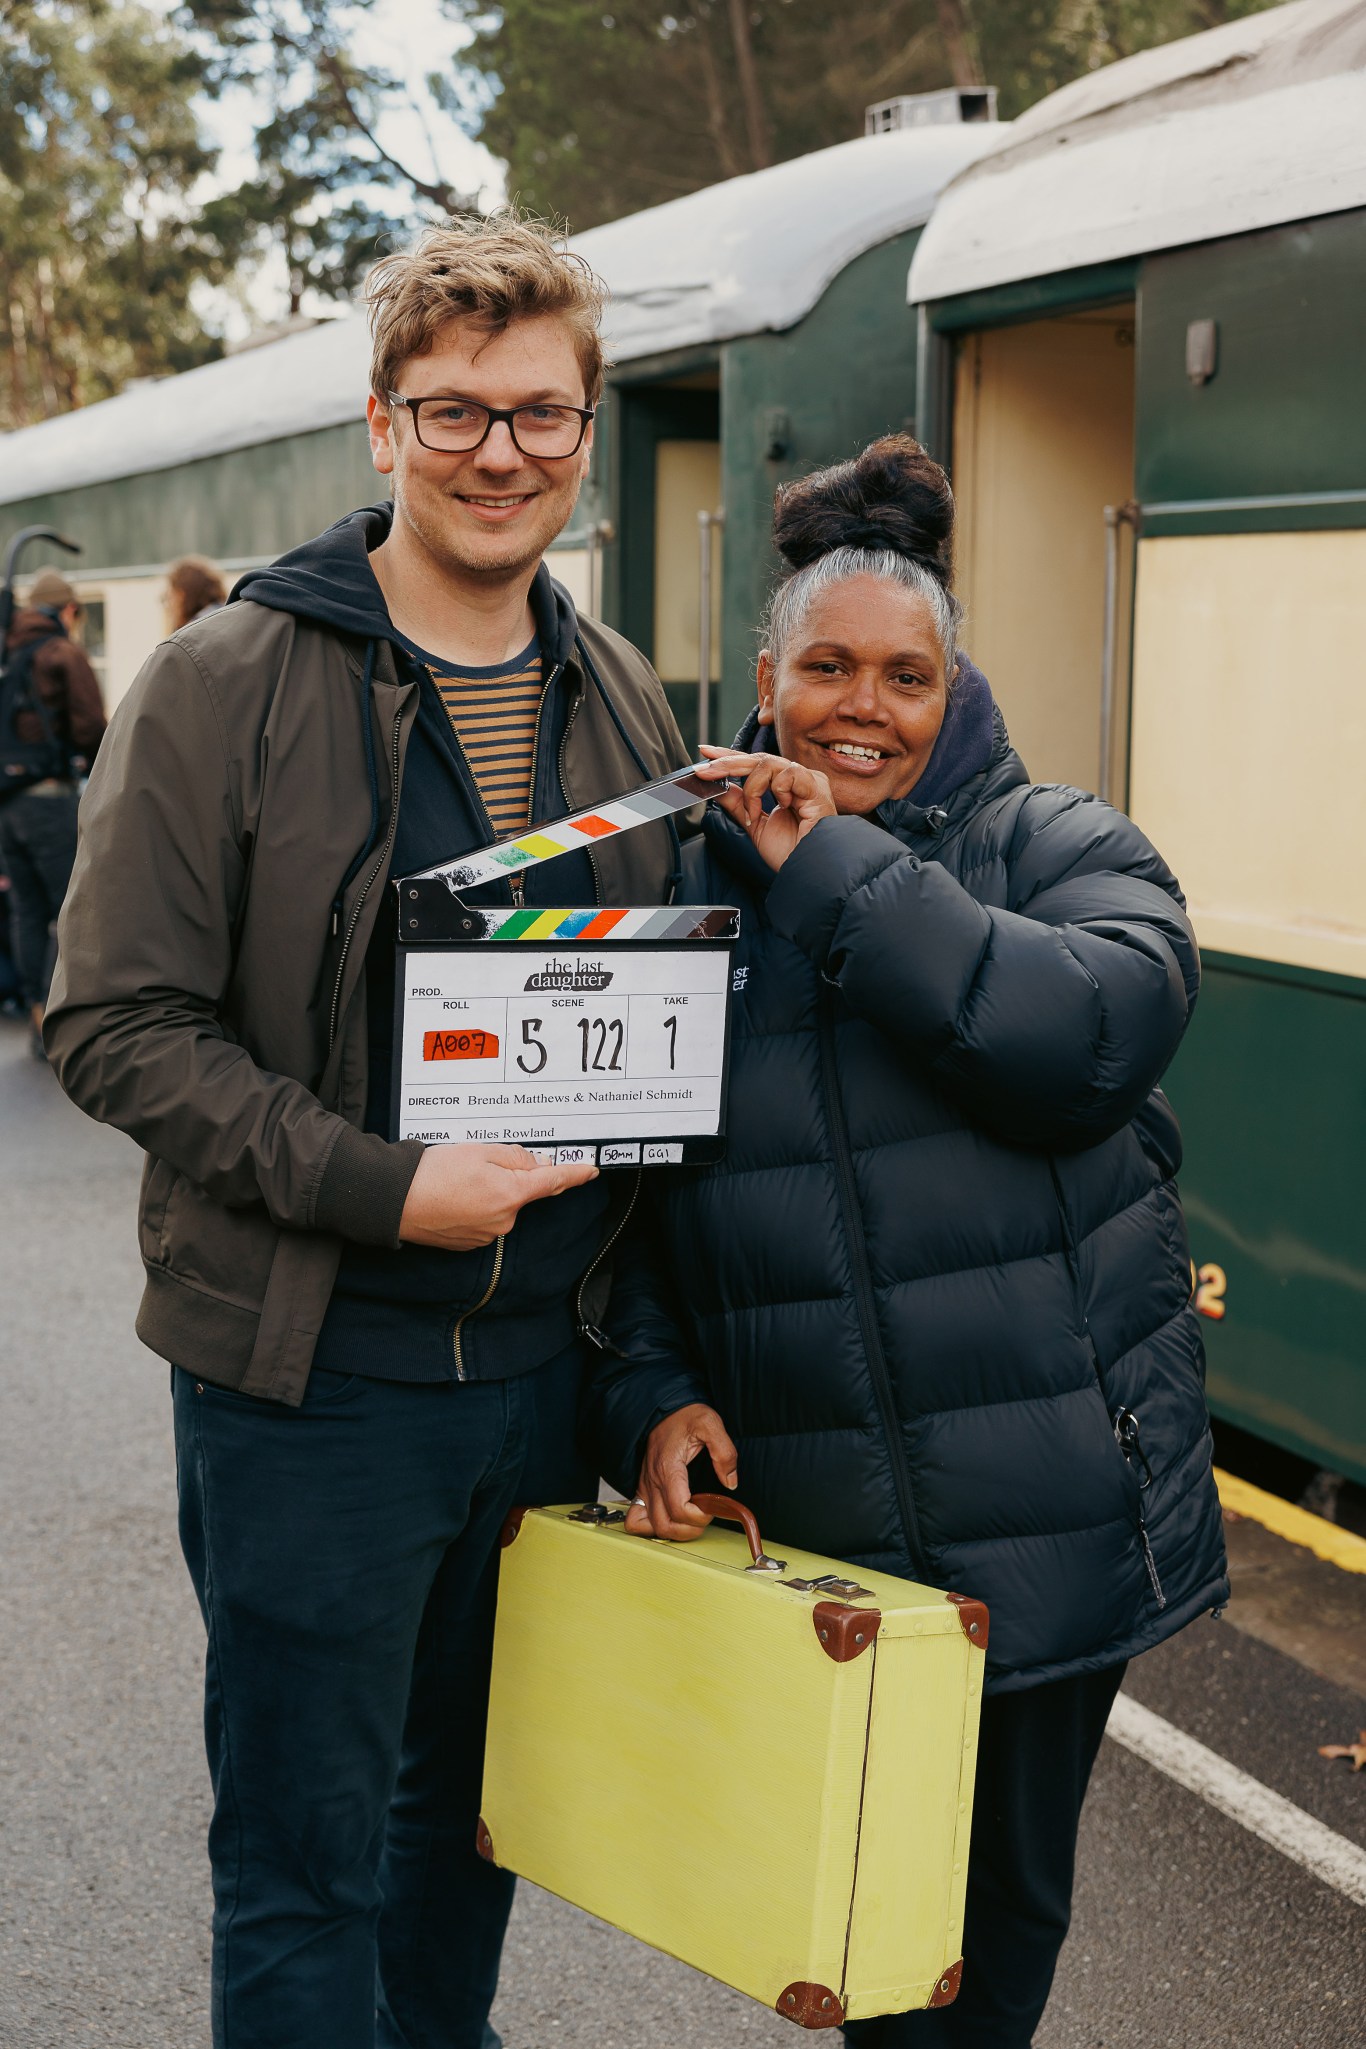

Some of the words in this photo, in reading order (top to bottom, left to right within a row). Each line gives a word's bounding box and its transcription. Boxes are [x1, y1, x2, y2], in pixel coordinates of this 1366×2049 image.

[545, 957, 572, 974] the
[576, 957, 603, 974] last
[531, 972, 605, 991] daughter
[412, 988, 443, 996] PROD.
[443, 1001, 470, 1010] ROLL
[551, 999, 585, 1007] SCENE
[663, 997, 689, 1005] TAKE
[431, 1032, 486, 1061] A007
[516, 1018, 548, 1074] 5
[576, 1017, 624, 1072] 122
[663, 1015, 677, 1070] 1
[408, 1097, 460, 1106] DIRECTOR
[467, 1095, 510, 1106] Brenda
[513, 1093, 570, 1104] Matthews
[573, 1092, 585, 1103] &
[588, 1090, 643, 1102] Nathaniel
[646, 1088, 693, 1100] Schmidt
[407, 1132, 450, 1140] CAMERA
[466, 1129, 499, 1140] Miles
[503, 1127, 555, 1139] Rowland
